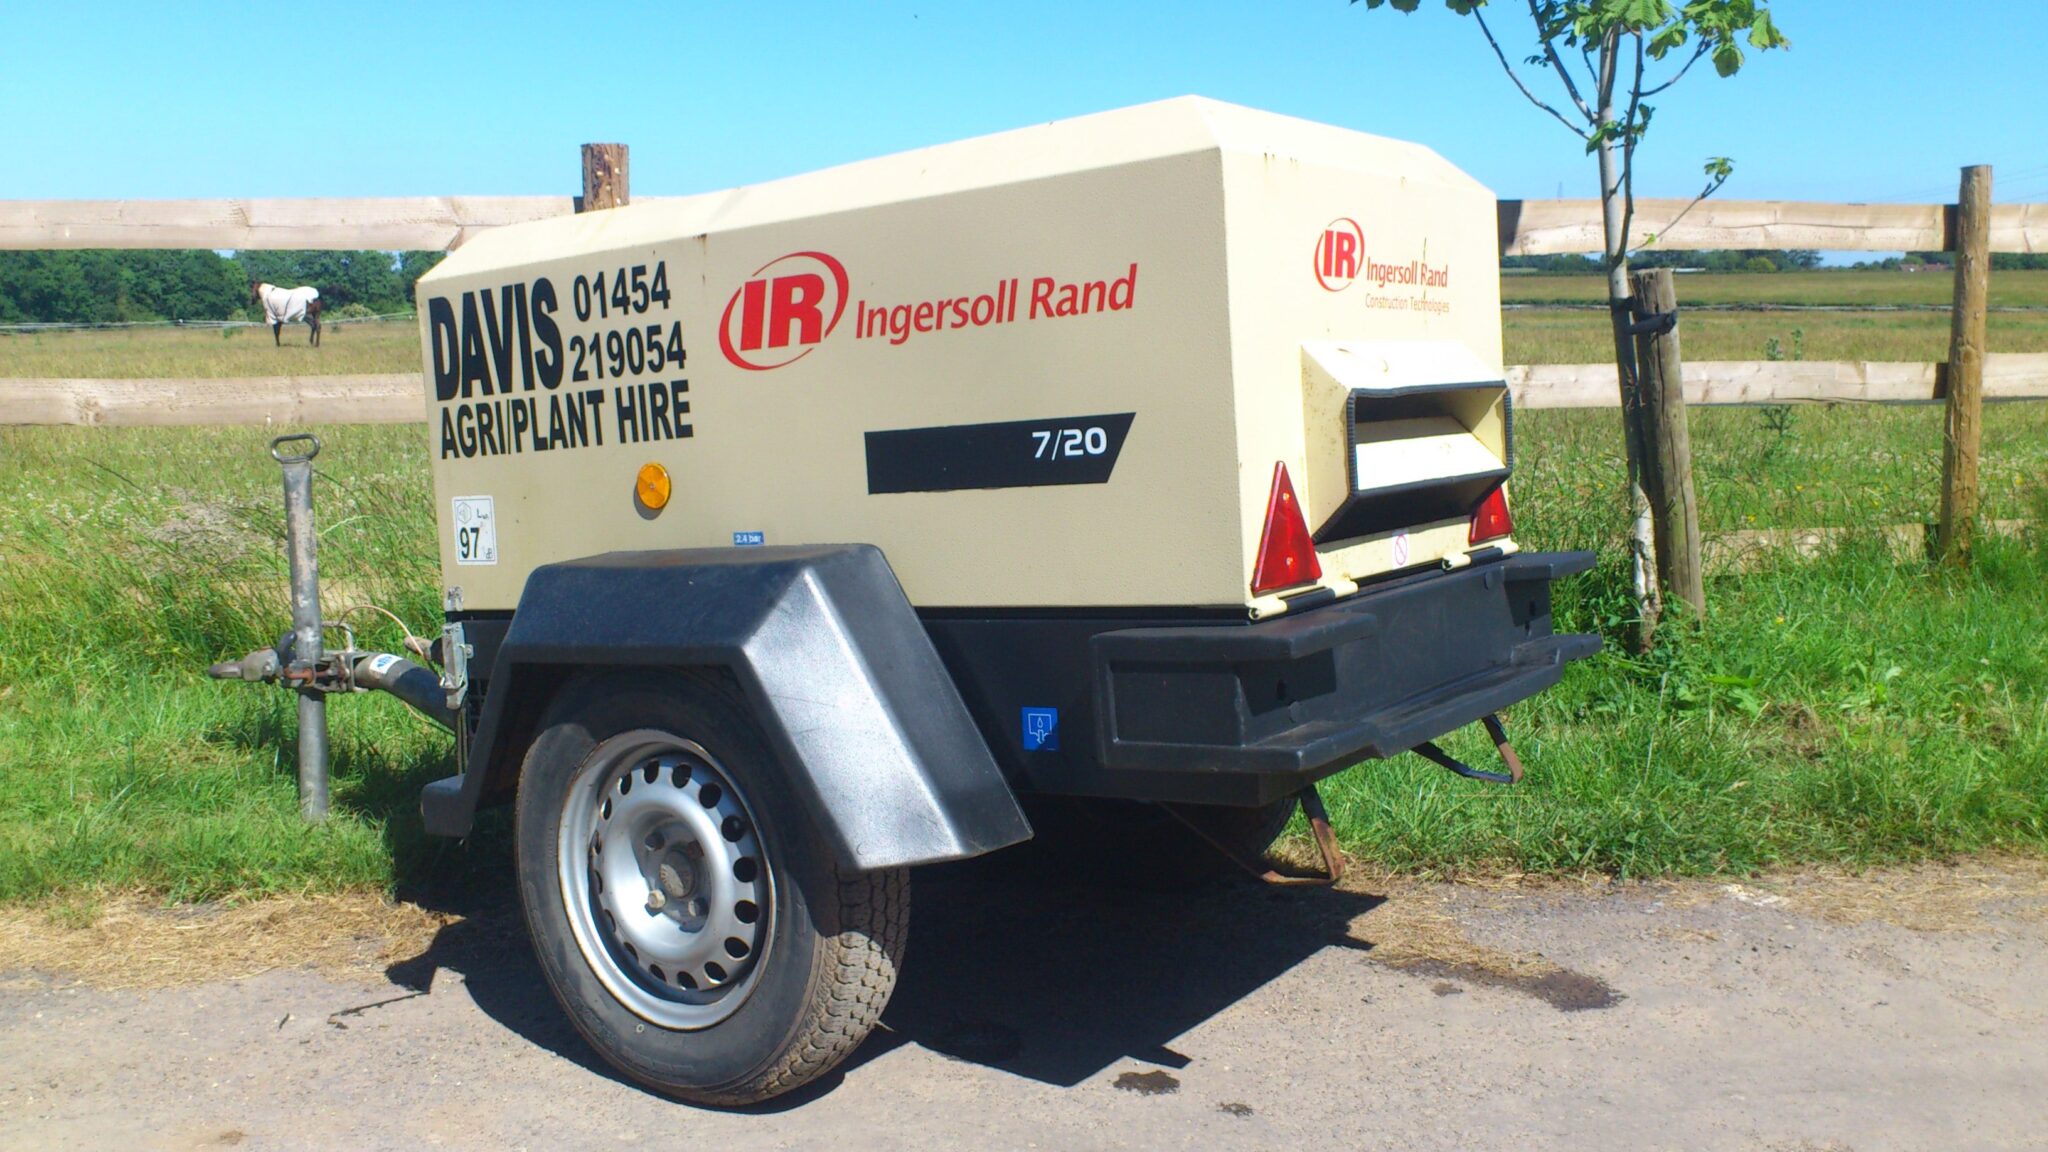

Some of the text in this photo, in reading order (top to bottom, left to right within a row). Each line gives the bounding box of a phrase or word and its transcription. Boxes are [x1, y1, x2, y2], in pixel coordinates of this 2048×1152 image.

[1323, 230, 1356, 279] IR
[1366, 257, 1448, 288] Ingersoll Rand
[573, 260, 671, 322] 01454
[740, 273, 825, 351] IR
[856, 263, 1138, 346] Ingersoll Rand
[1365, 293, 1450, 315] Construction Technologies
[428, 277, 565, 401] DAVIS
[569, 320, 687, 383] 219054
[441, 379, 694, 460] AGRI/PLANT HIRE
[1032, 426, 1107, 461] 7/20
[460, 526, 480, 559] 97
